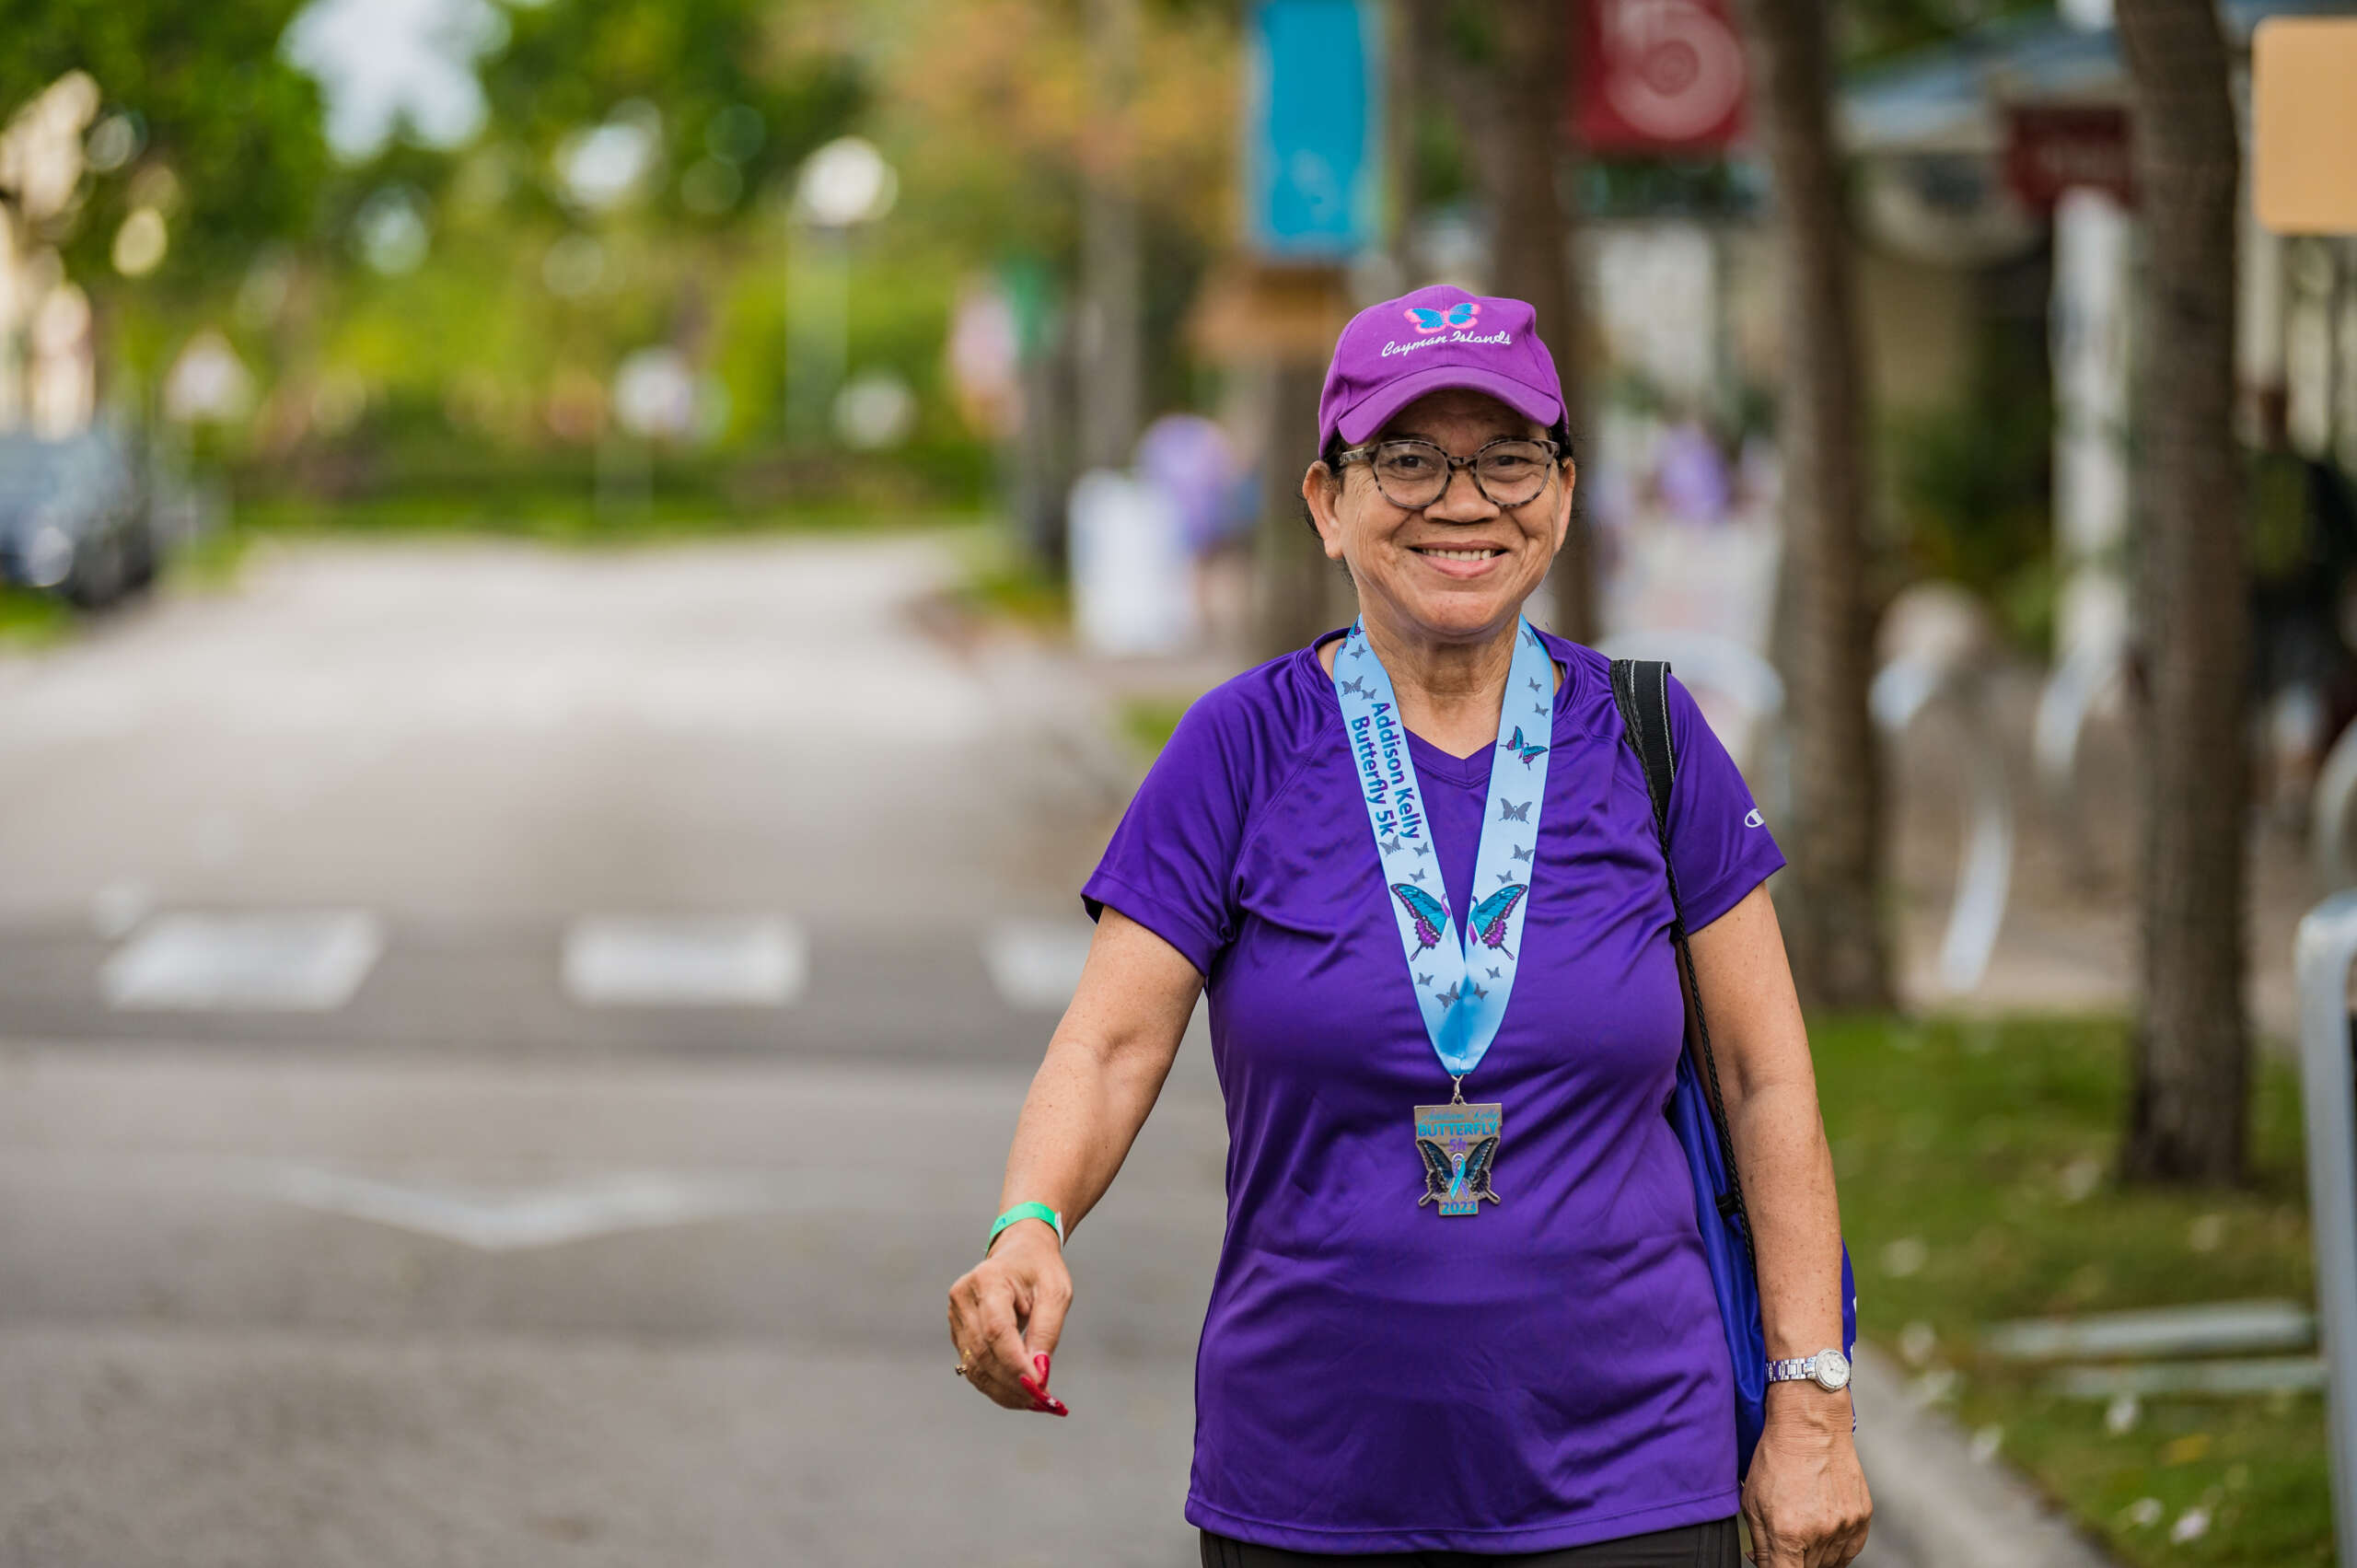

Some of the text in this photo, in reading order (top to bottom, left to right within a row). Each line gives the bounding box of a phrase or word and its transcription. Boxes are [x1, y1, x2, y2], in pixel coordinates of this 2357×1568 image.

[1381, 330, 1512, 357] Cayman Islands
[1351, 715, 1399, 837] Butterfly 5k
[1371, 702, 1422, 839] Addison Kelly
[1418, 1121, 1498, 1137] BUTTERFLY
[1441, 1201, 1477, 1214] 2023
